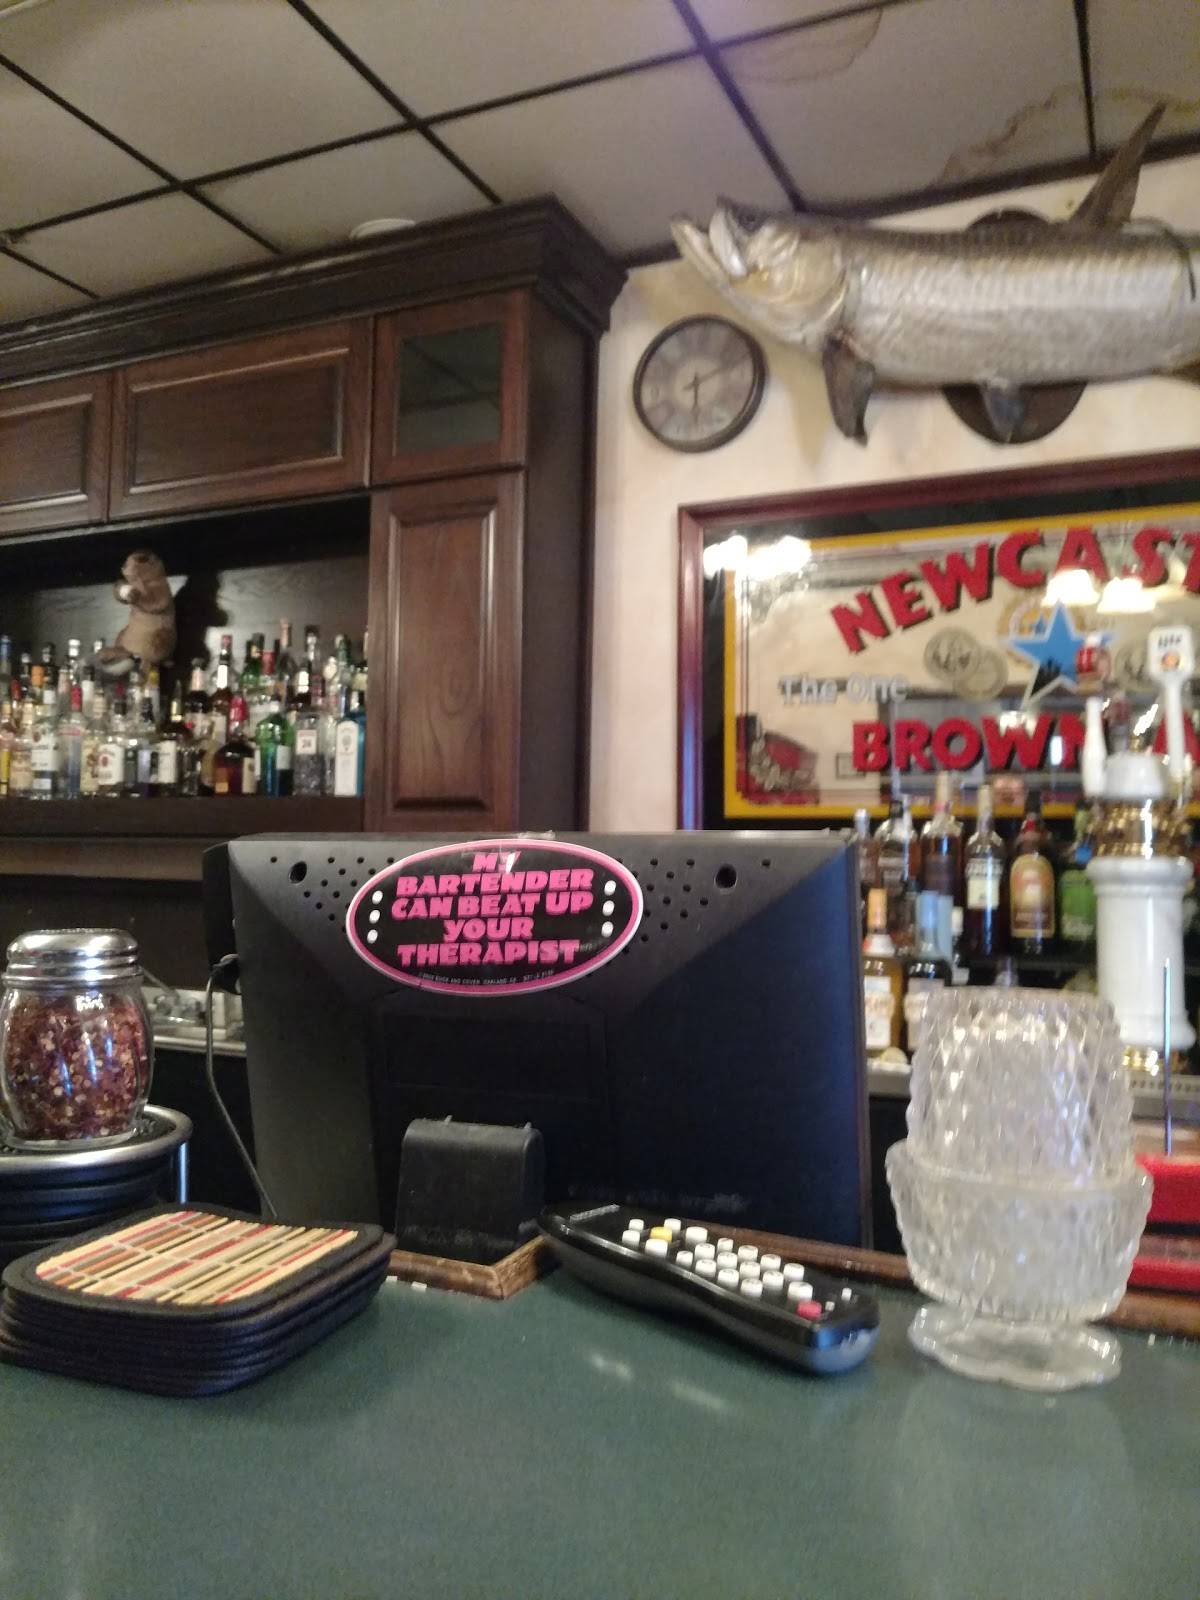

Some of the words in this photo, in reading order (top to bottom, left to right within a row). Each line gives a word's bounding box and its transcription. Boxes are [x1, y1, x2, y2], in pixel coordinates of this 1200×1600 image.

[780, 673, 838, 704] The
[846, 672, 911, 704] One
[472, 851, 521, 873] MY
[396, 869, 594, 896] BARTENDER
[391, 896, 453, 920] CAN
[457, 892, 541, 919] BEAT
[545, 891, 594, 915] UP
[443, 917, 534, 942] YOUR
[397, 940, 580, 967] THERAPIST
